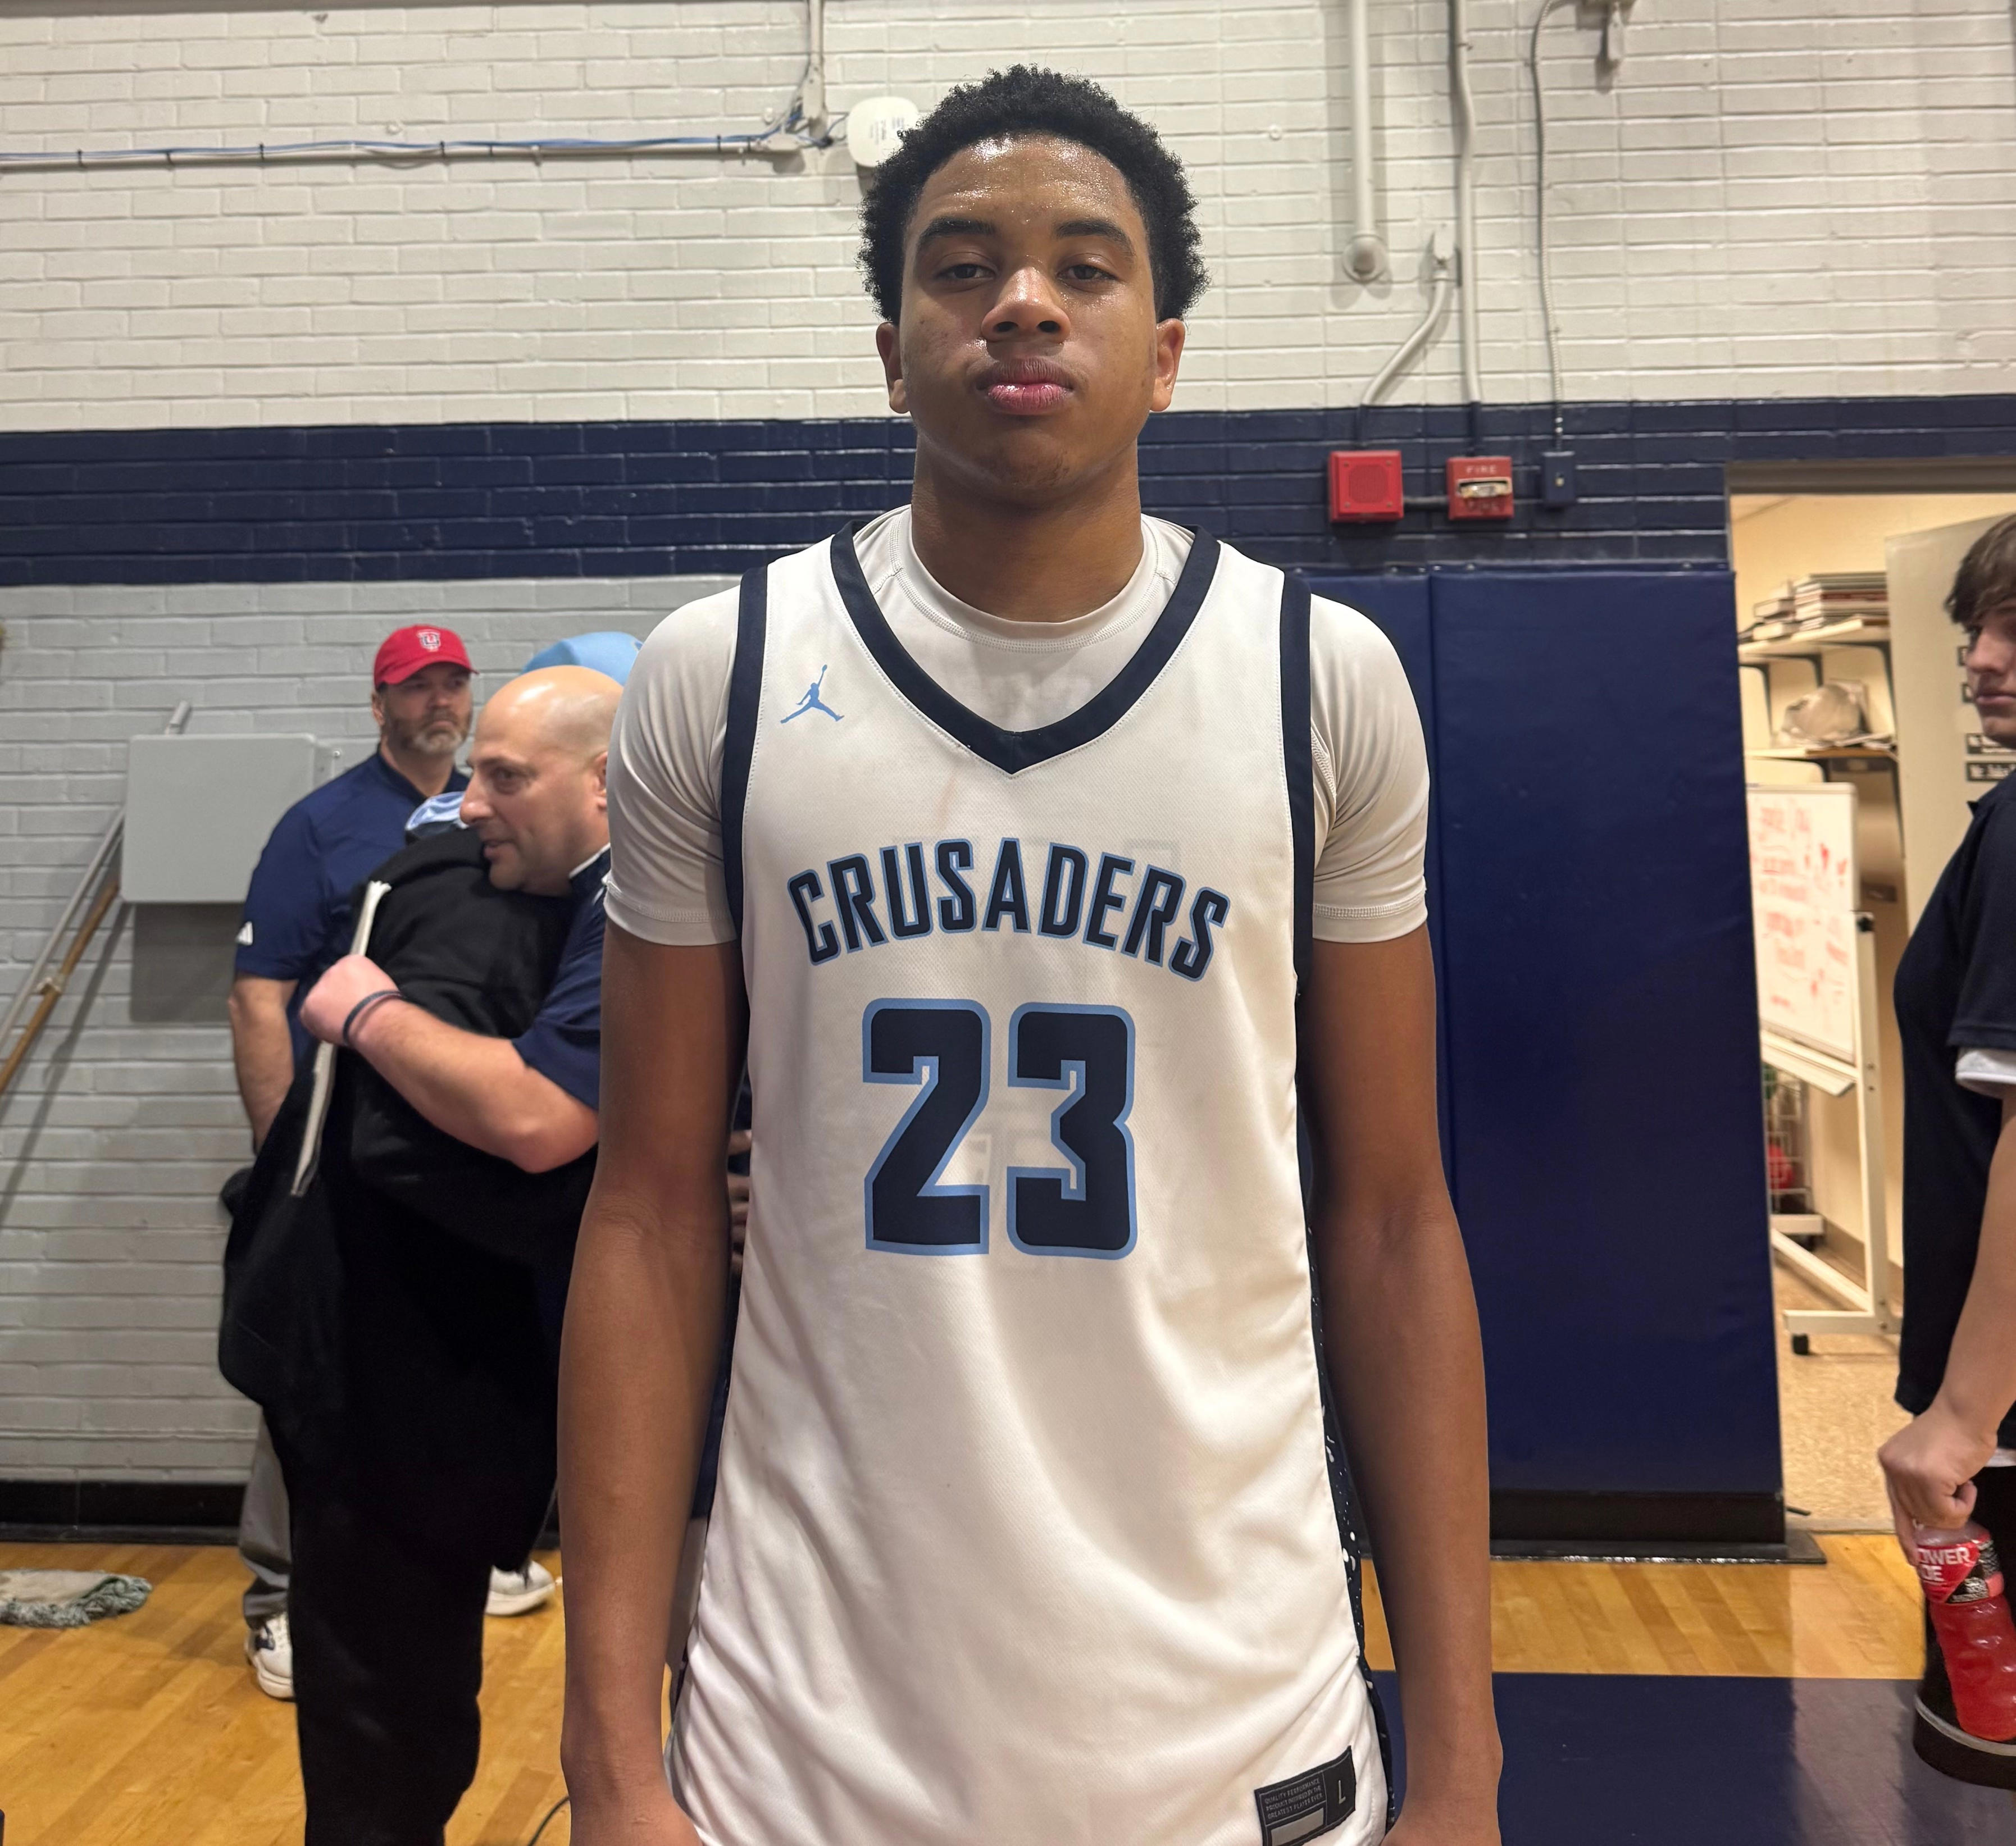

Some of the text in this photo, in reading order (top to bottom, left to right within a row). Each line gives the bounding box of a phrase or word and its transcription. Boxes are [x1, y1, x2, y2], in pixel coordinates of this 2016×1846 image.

[1466, 465, 1497, 474] FIRE
[787, 837, 1231, 982] CRUSADERS
[862, 997, 1137, 1260] 23
[1918, 1547, 1970, 1565] OWER
[1338, 1780, 1346, 1804] L
